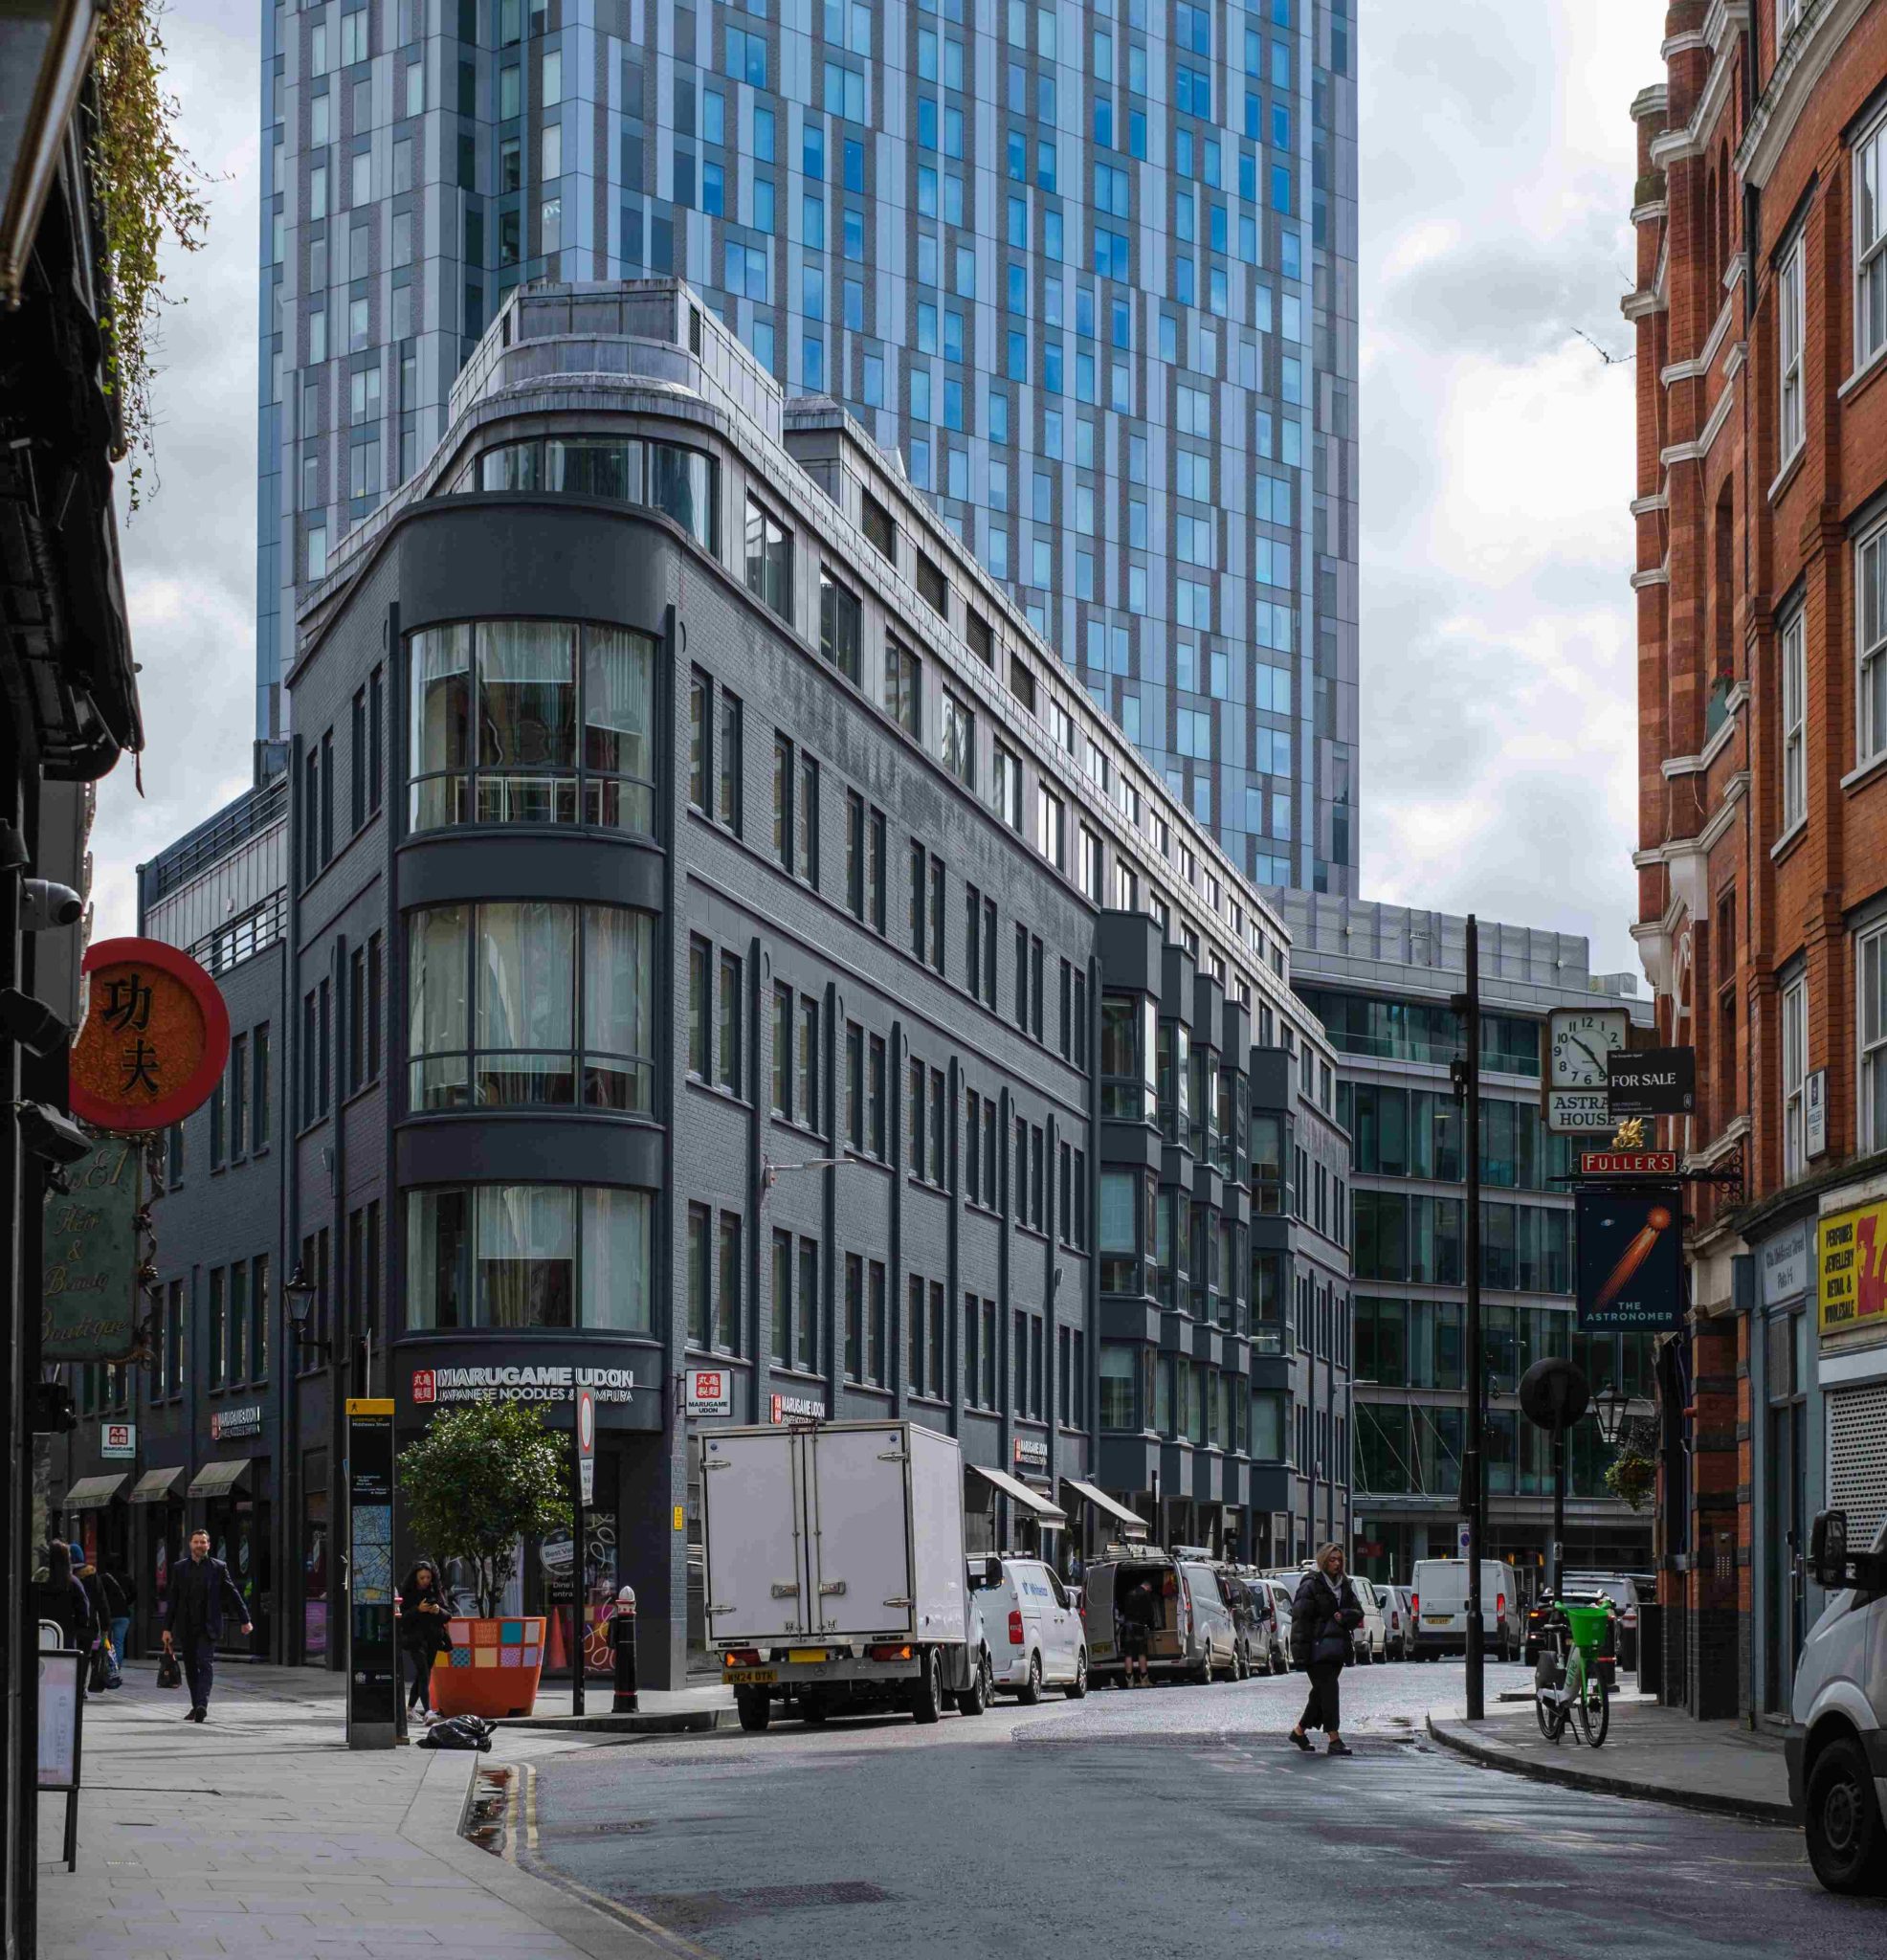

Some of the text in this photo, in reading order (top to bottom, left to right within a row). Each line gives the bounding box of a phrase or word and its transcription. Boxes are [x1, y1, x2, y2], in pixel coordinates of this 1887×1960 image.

[1568, 1021, 1577, 1032] 11
[1582, 1016, 1593, 1028] 12
[1601, 1021, 1605, 1032] 1
[101, 971, 161, 1095] 功夫
[1557, 1033, 1568, 1044] 10
[1610, 1033, 1618, 1043] 2
[1553, 1046, 1562, 1057] 9
[1559, 1061, 1567, 1072] 8
[1571, 1071, 1579, 1081] 7
[1584, 1075, 1592, 1085] 6
[1611, 1072, 1676, 1087] FOR SALE
[1560, 1112, 1617, 1126] HOUSE
[1586, 1154, 1671, 1171] FULLER'S
[1826, 1222, 1854, 1249] PERFUMES
[1825, 1248, 1854, 1275] JEWELLERY
[1827, 1278, 1845, 1299] RETAIL
[1617, 1302, 1642, 1310] THE
[1824, 1299, 1854, 1324] WHOLESALE
[1586, 1312, 1673, 1322] ASTRONOMER
[436, 1367, 633, 1388] MARUGAME UDON
[437, 1387, 498, 1402] JAPANESE
[499, 1387, 566, 1401] NOODLES
